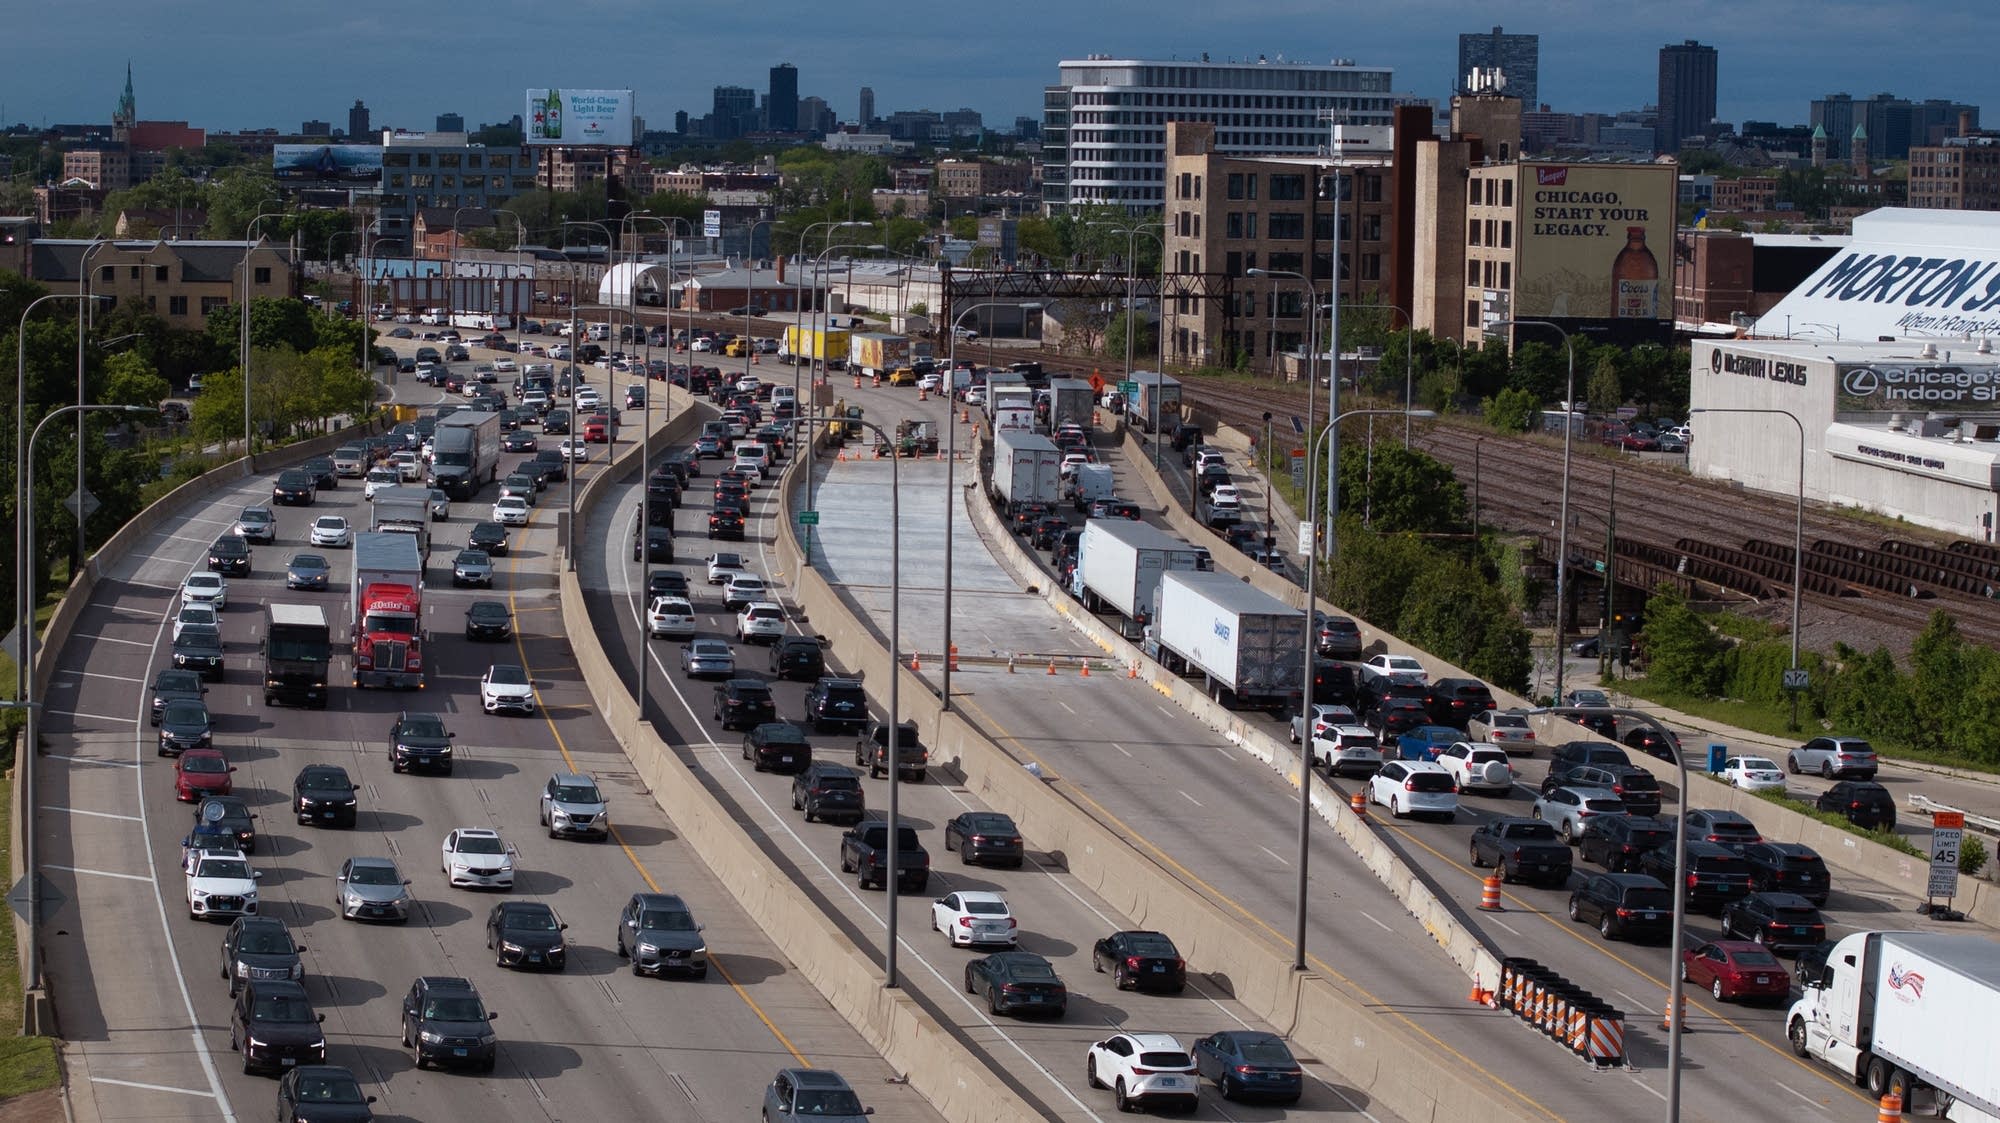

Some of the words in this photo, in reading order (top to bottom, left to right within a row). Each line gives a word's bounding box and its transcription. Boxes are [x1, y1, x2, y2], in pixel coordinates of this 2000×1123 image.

[571, 96, 619, 105] World-Class
[573, 105, 594, 113] Light
[1539, 169, 1566, 184] Banquet
[1535, 191, 1622, 205] CHICAGO,
[1534, 207, 1594, 219] START
[1599, 208, 1648, 221] YOUR
[1533, 223, 1609, 236] LEGACY.
[1620, 281, 1649, 293] Coors
[1804, 253, 1998, 309] MORTON
[1620, 308, 1649, 316] BEER
[1895, 312, 1936, 328] When
[1930, 315, 1950, 329] It
[1940, 315, 1984, 333] Rains
[1768, 360, 1807, 386] LEXUS
[1884, 369, 2000, 387] Chicago's
[1886, 385, 1968, 400] Indoor
[1935, 831, 1960, 839] SPEED
[1935, 850, 1956, 863] 45
